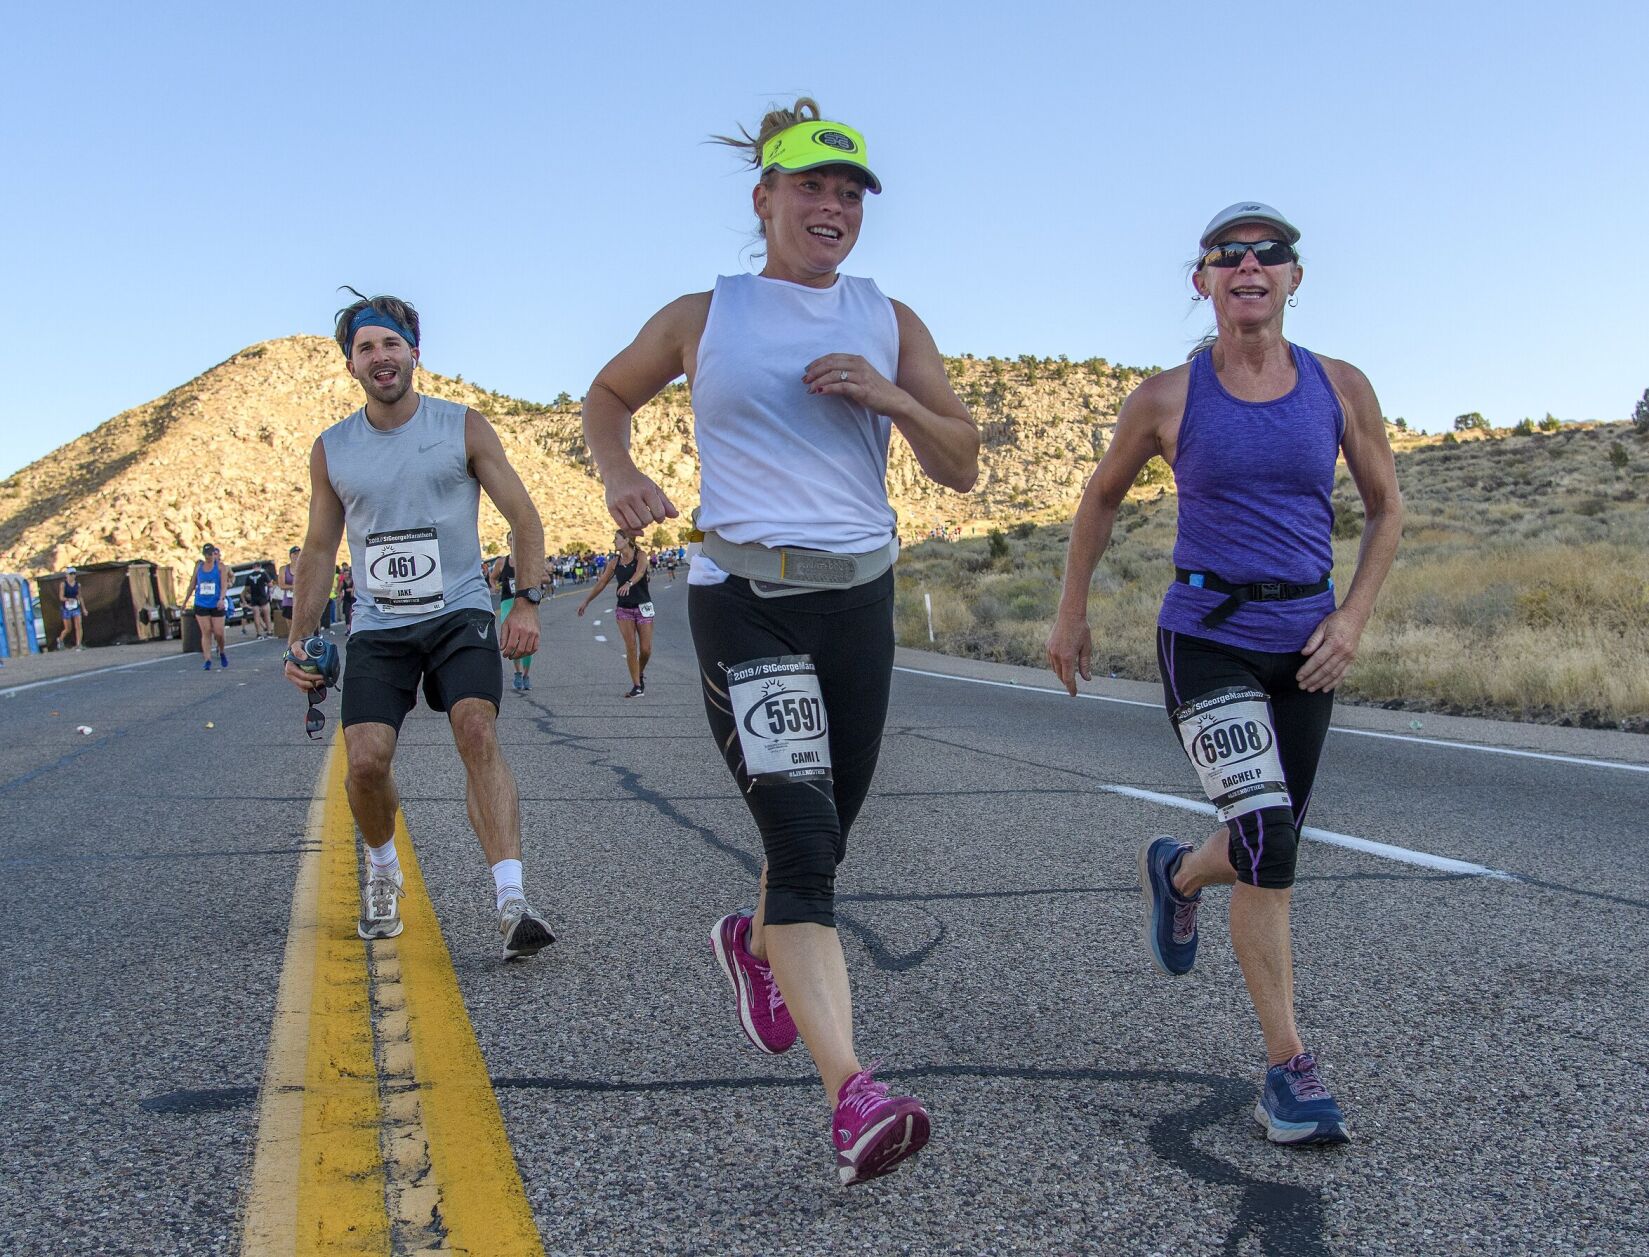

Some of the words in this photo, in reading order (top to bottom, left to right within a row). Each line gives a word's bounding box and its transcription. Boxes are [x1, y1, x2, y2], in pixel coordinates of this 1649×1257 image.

[388, 556, 416, 578] 461
[733, 667, 754, 681] 2019
[765, 698, 821, 734] 5597
[1200, 721, 1262, 764] 6908
[791, 751, 814, 764] CAMI
[1221, 770, 1255, 788] RACHEL
[1256, 768, 1262, 778] P
